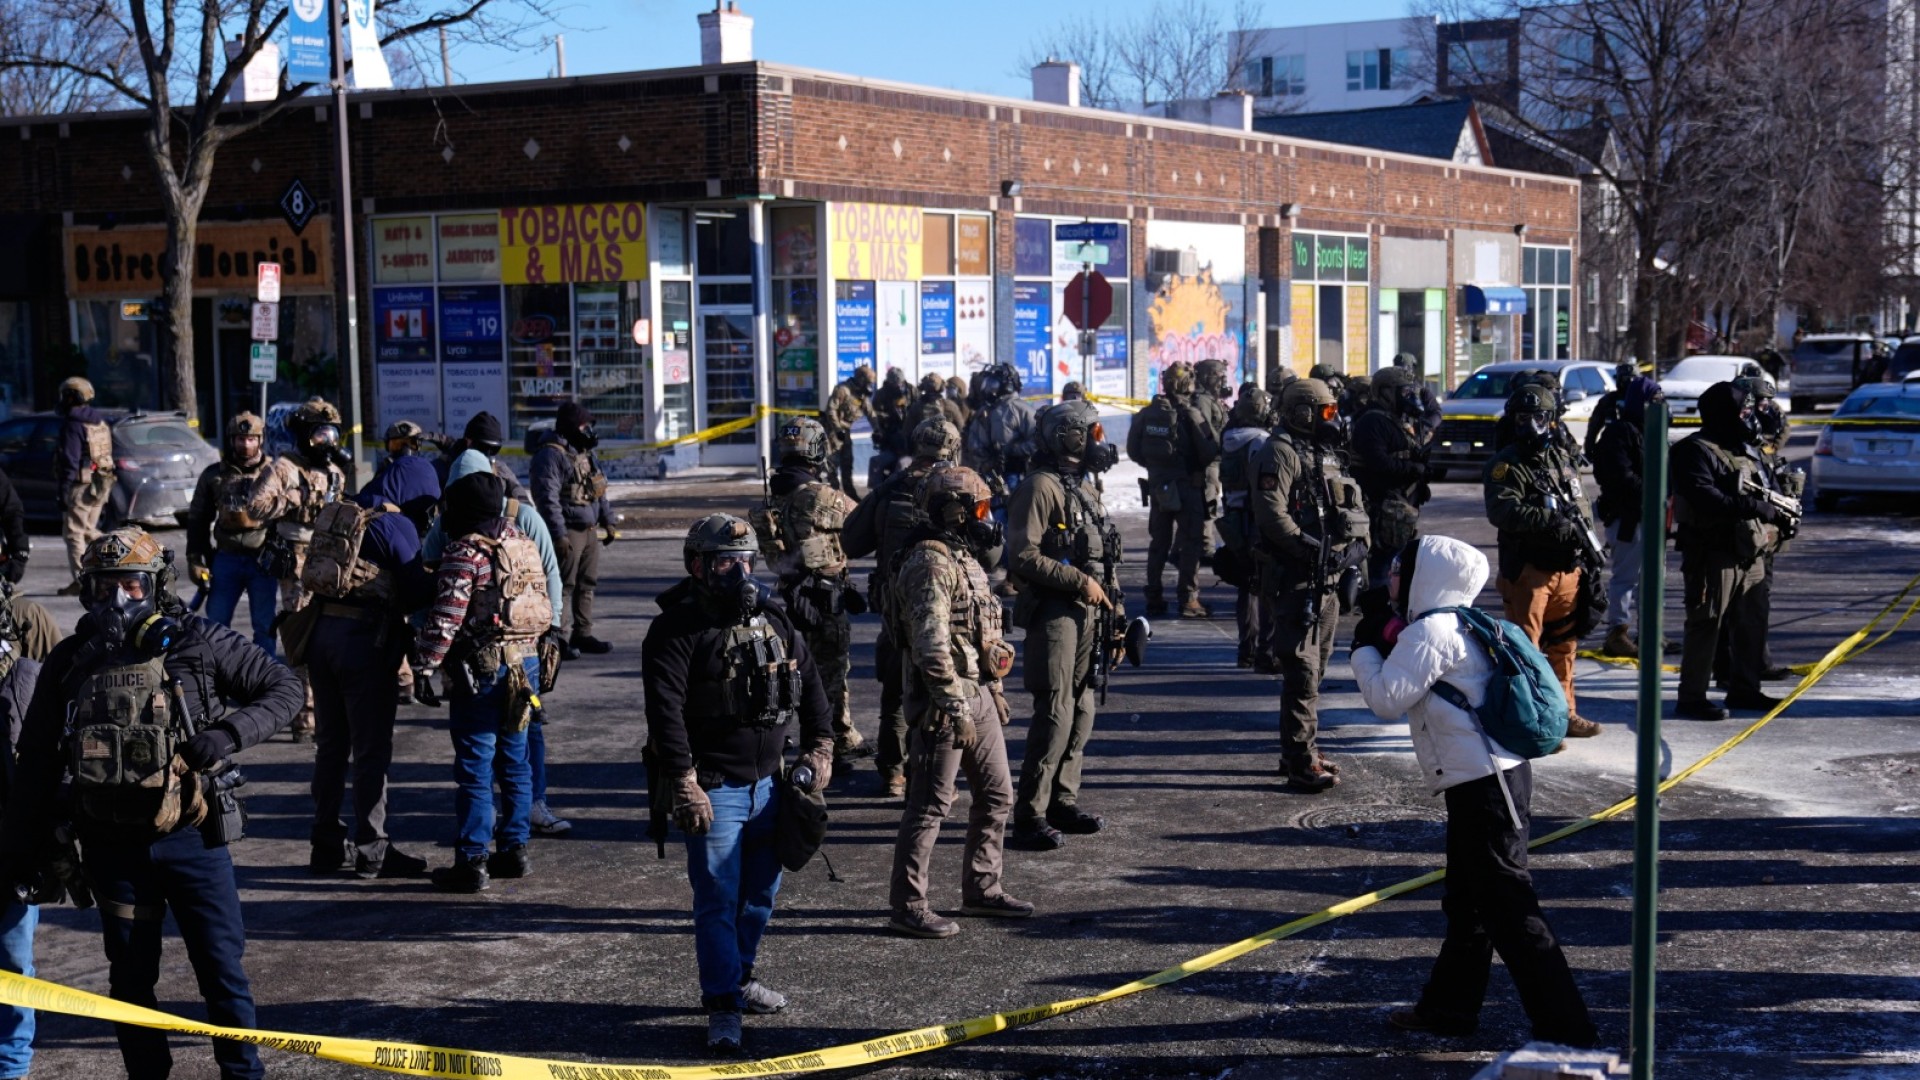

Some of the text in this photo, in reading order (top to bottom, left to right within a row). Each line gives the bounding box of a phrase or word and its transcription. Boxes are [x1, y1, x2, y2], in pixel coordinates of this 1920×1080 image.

[292, 190, 304, 214] 8
[502, 203, 642, 246] TOBACCO
[833, 203, 920, 244] TOBACCO
[1058, 225, 1117, 238] Nicollet Av
[198, 238, 316, 278] Nourish
[381, 253, 428, 268] T-SHIRTS
[446, 249, 495, 264] JARRITOS
[526, 243, 623, 284] & MAS
[848, 242, 908, 280] & MAS
[1295, 241, 1308, 266] Yo
[1316, 244, 1344, 274] Sports
[387, 292, 423, 303] Unlimited
[923, 298, 949, 309] Unlimited
[444, 307, 473, 315] Unlimited
[838, 304, 870, 316] Unlimited
[477, 316, 498, 336] $19
[382, 368, 413, 376] TOBACCO
[421, 368, 435, 376] MAS
[1028, 350, 1047, 377] $10
[580, 369, 627, 388] GLASS
[520, 378, 564, 397] VAPOR
[1146, 424, 1169, 433] POLICE
[513, 580, 545, 592] POCE
[95, 672, 145, 689] POLICE
[282, 1039, 322, 1055] CROSS
[863, 1024, 967, 1057] POLICE LINE DO NOT CROSS
[372, 1046, 502, 1077] POLICE LINE DO NOT CROSS
[793, 1053, 825, 1069] CROSS
[547, 1064, 579, 1080] POLICE
[579, 1067, 602, 1080] LINE
